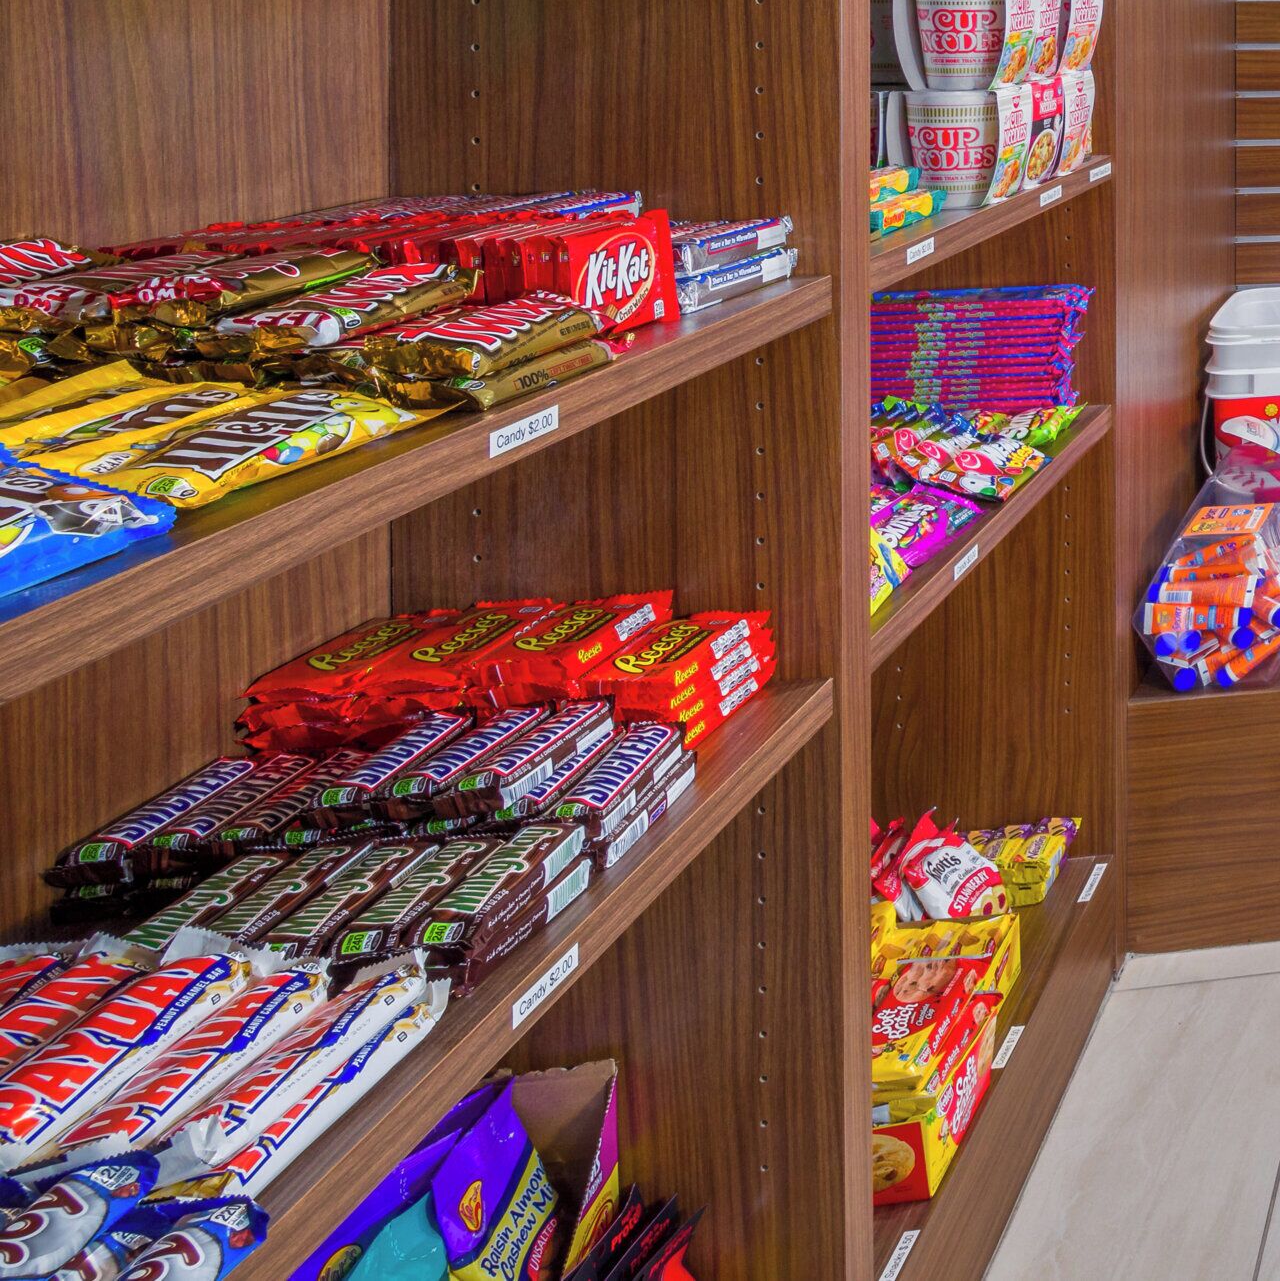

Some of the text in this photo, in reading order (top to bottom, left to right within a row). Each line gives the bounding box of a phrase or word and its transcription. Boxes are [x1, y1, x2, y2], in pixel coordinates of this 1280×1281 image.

[932, 9, 998, 32] CUP
[1009, 11, 1035, 32] NOODLES
[918, 127, 981, 149] CUP
[516, 370, 549, 390] 100%
[496, 413, 554, 449] Candy $2.00
[412, 613, 508, 663] Reese's
[515, 608, 604, 652] Reese's
[614, 622, 702, 675] Reese's
[578, 642, 603, 664] Reese's
[675, 662, 699, 687] Reese's
[572, 725, 672, 807] SNICKERS
[925, 853, 962, 885] Knott's
[952, 873, 990, 914] STRAWBERRY
[153, 966, 224, 1032] PEANUT CARAMEL BAR
[518, 954, 574, 1016] Candy $2.00
[242, 980, 302, 1038] PEANUT CARAMEL BAR
[872, 1008, 898, 1035] Soft
[888, 1002, 919, 1040] Batch
[353, 1044, 372, 1068] PEANUT
[481, 1226, 514, 1279] Raisin
[499, 1212, 537, 1281] Cashew
[529, 1218, 558, 1271] UNSALTED
[884, 1251, 905, 1279] Snacks
